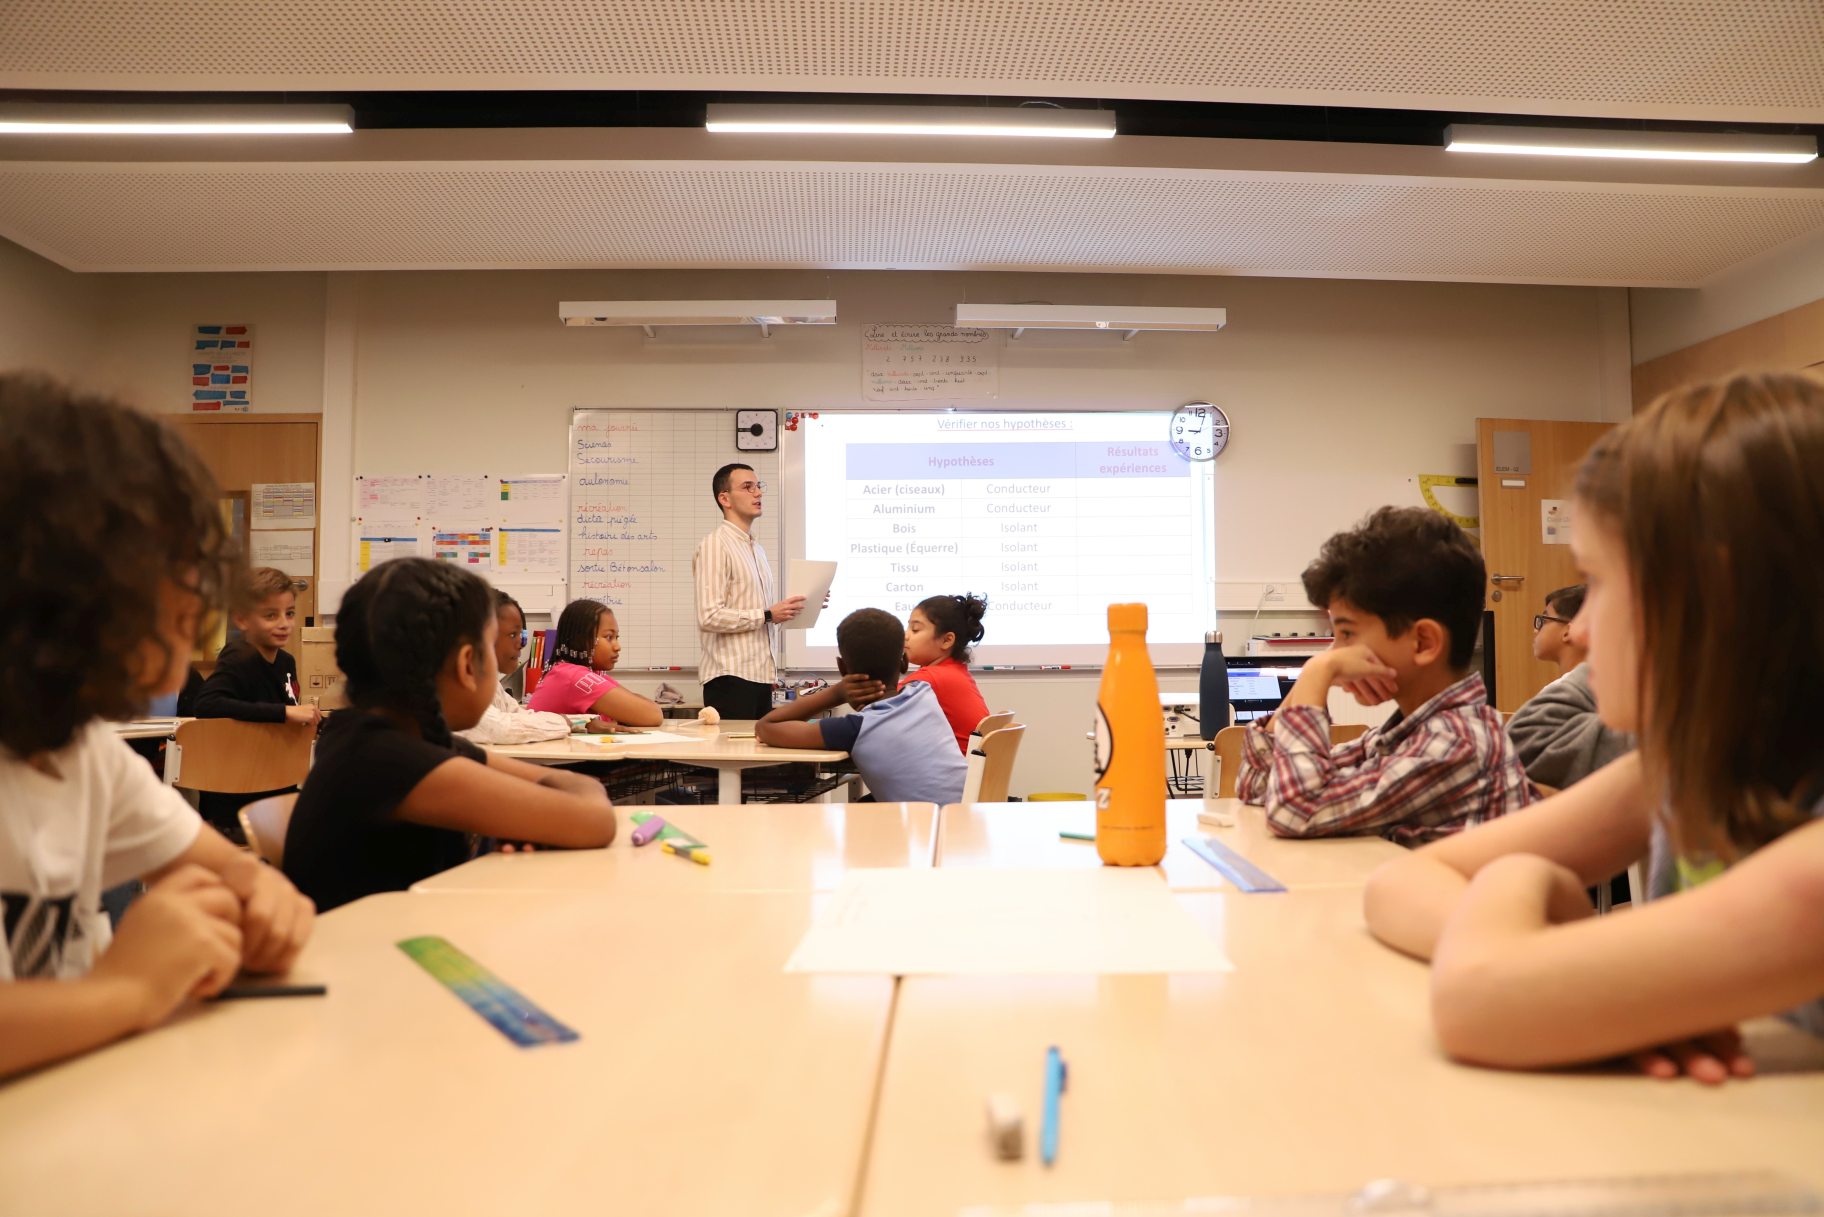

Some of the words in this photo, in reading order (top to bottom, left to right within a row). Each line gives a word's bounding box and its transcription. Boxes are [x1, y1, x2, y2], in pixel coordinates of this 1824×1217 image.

[936, 331, 958, 341] grands
[1195, 408, 1205, 417] 12
[937, 418, 978, 429] Vérifier
[981, 421, 1000, 429] nos
[1003, 418, 1066, 432] hypothèses
[1215, 429, 1222, 437] 3
[1107, 446, 1159, 457] Résultats
[1195, 447, 1202, 455] 6
[928, 455, 994, 468] Hypothèses
[1100, 463, 1167, 475] expériences
[863, 484, 892, 495] Acier
[895, 484, 945, 497] (ciseaux)
[986, 484, 1051, 494] Conducteur
[873, 504, 935, 514] Aluminium
[986, 503, 1051, 513] Conducteur
[579, 526, 618, 540] histoire
[621, 531, 634, 539] des
[892, 523, 916, 534] Bois
[1001, 522, 1038, 533] Isolant
[850, 543, 902, 556] Plastique
[906, 541, 958, 556] (Équerre)
[1001, 542, 1038, 553] Isolant
[890, 563, 918, 573] Tissu
[1001, 561, 1038, 572] Isolant
[885, 582, 924, 592] Carton
[1001, 581, 1039, 592] Isolant
[895, 602, 913, 611] Eau
[988, 600, 1052, 611] Conducteur
